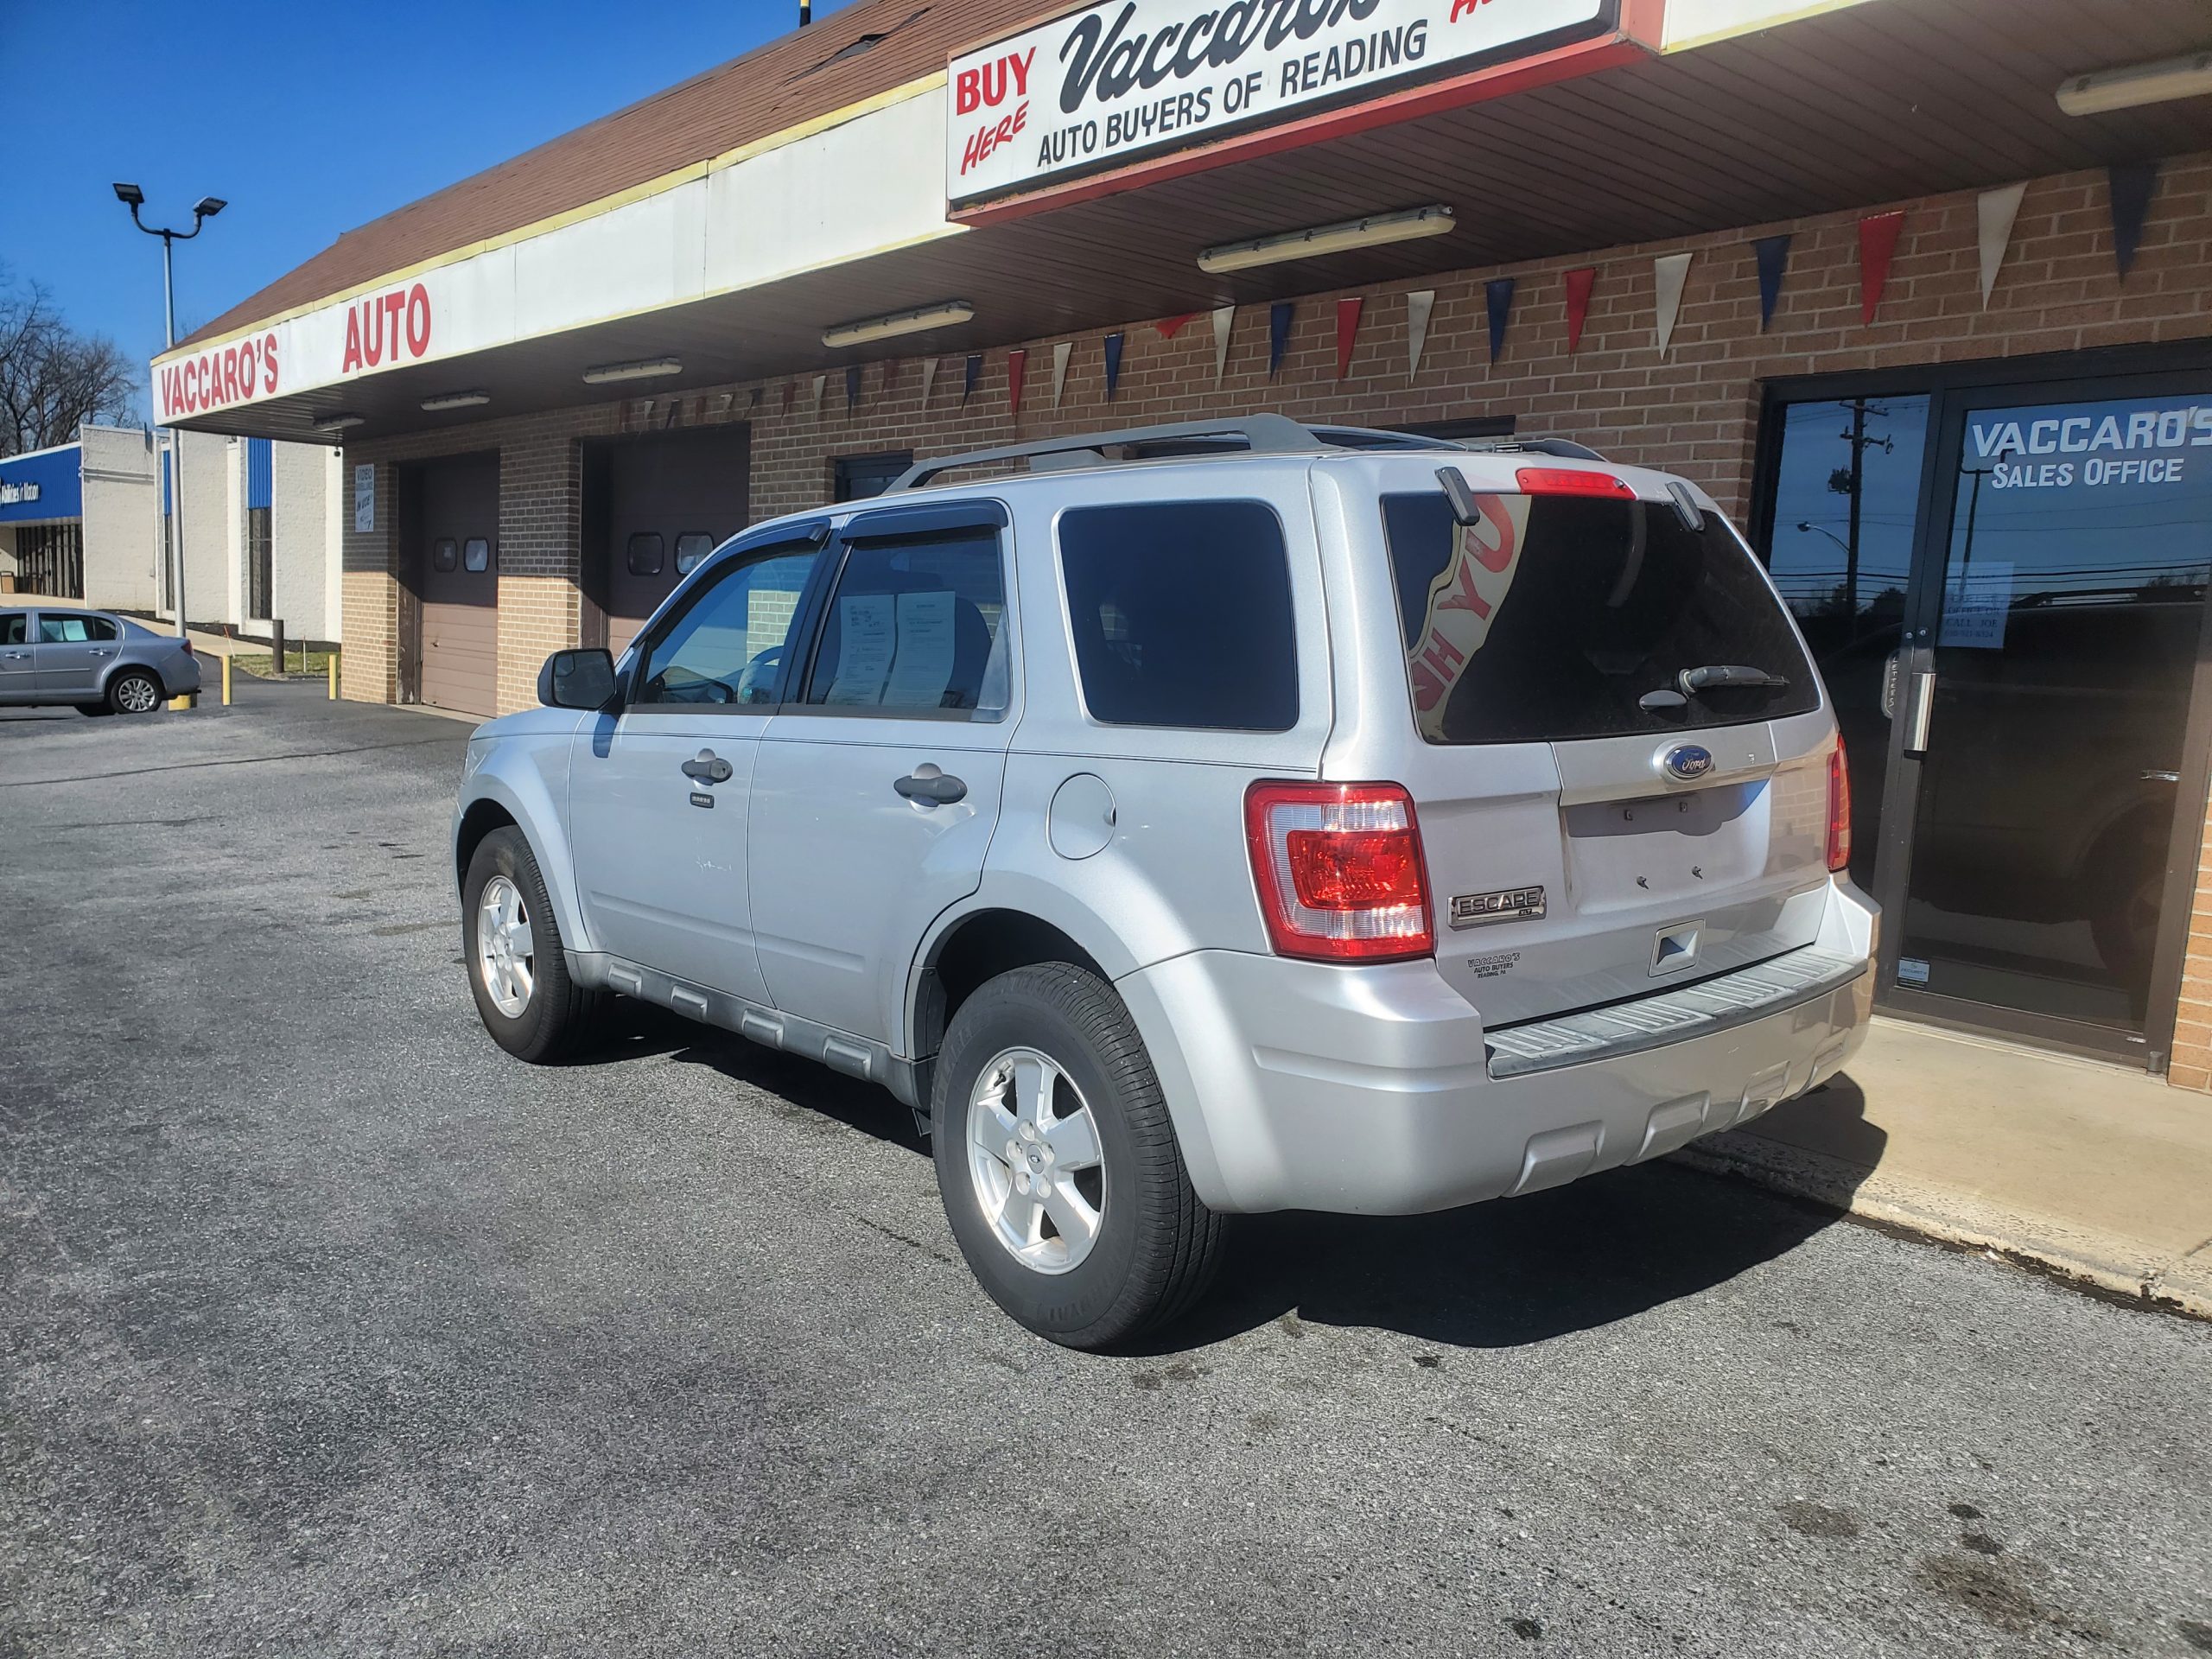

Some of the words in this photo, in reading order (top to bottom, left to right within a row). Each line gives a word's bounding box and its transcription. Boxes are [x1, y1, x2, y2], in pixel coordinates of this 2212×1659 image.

[956, 46, 1037, 116] BUY
[1037, 120, 1097, 168] AUTO
[1105, 86, 1213, 149] BUYERS
[1224, 71, 1262, 114] OF
[1280, 19, 1428, 99] READING
[959, 99, 1030, 175] HERE
[161, 333, 279, 417] VACCARO'S
[342, 283, 431, 374] AUTO
[357, 468, 373, 481] VIDEO
[1992, 461, 2075, 489] SALES
[2083, 457, 2185, 486] OFFICE
[1681, 753, 1707, 771] Ford
[1457, 891, 1540, 916] ESCAPE
[1473, 965, 1491, 974] AUTO
